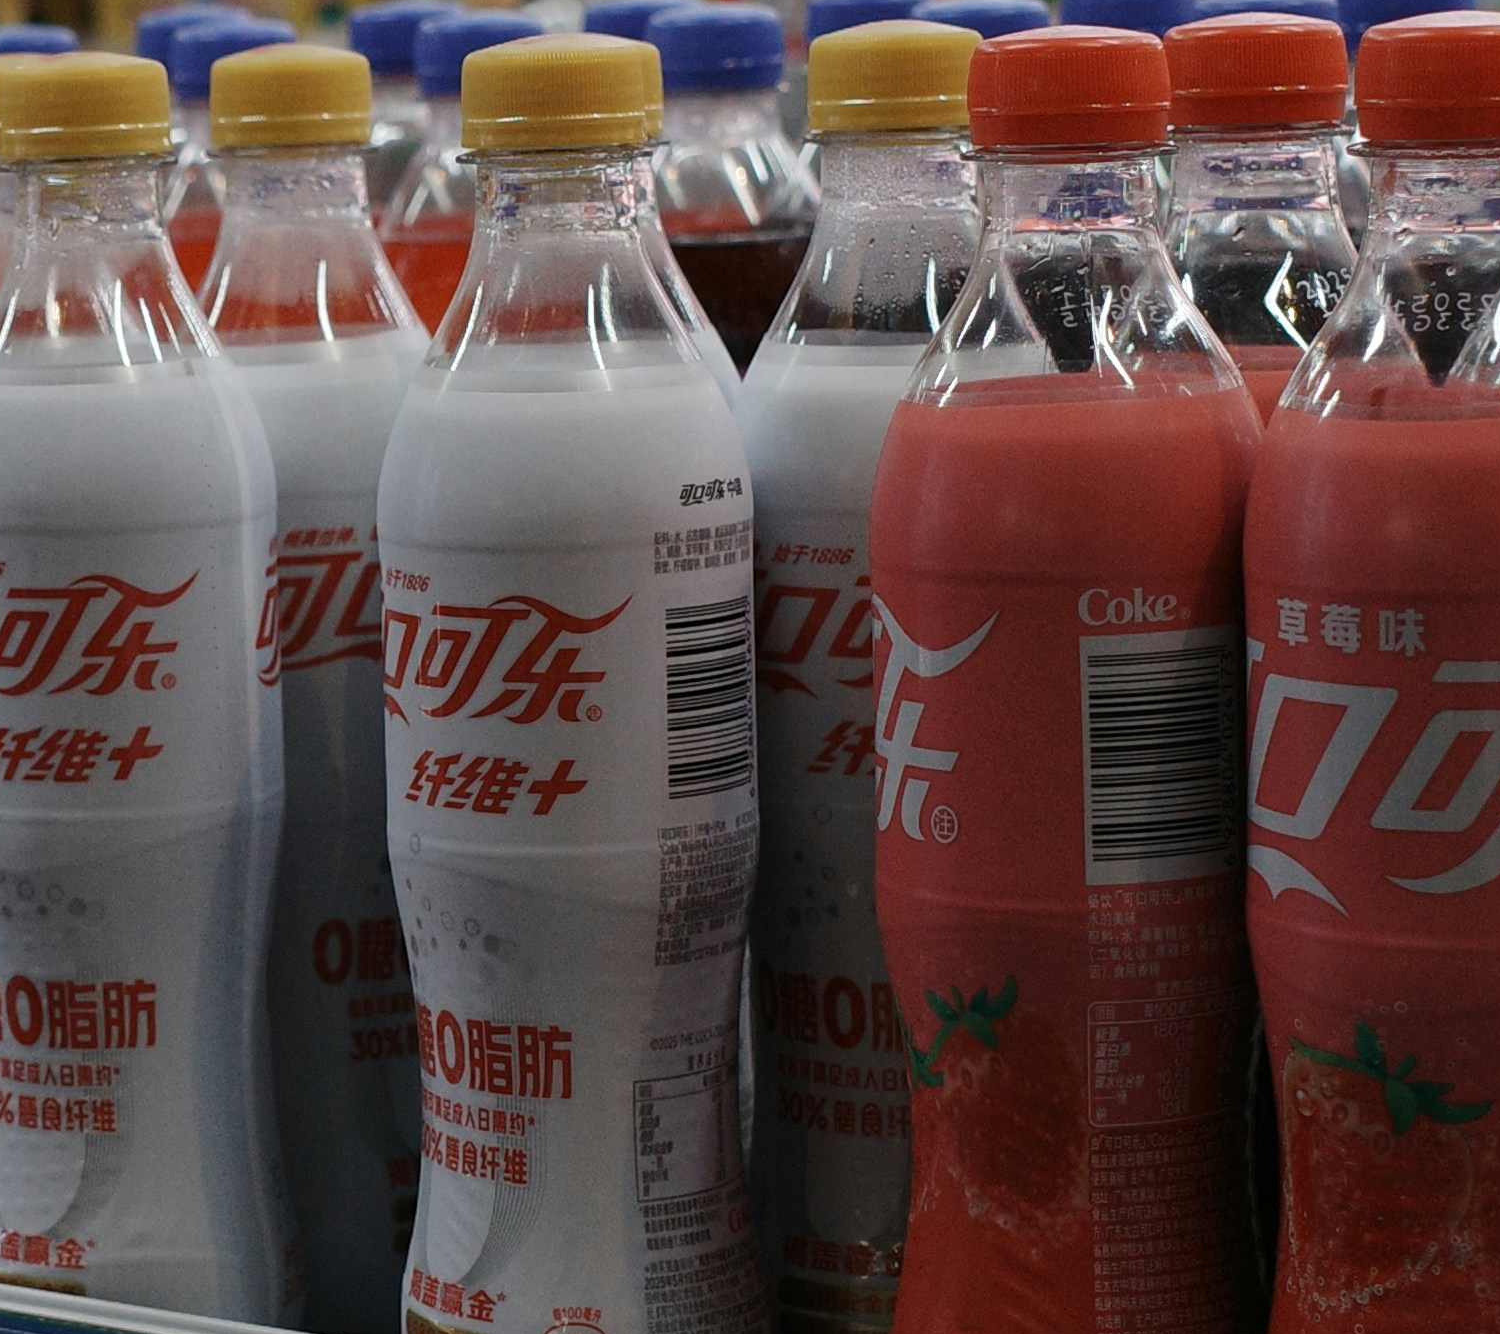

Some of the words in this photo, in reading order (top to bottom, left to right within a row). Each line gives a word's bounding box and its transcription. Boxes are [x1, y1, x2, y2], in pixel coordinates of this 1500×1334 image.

[772, 543, 854, 566] 始于1886
[1077, 586, 1179, 626] Coke
[1276, 597, 1426, 658] 草莓味
[405, 749, 588, 816] 纤维+
[313, 917, 408, 986] 0糖
